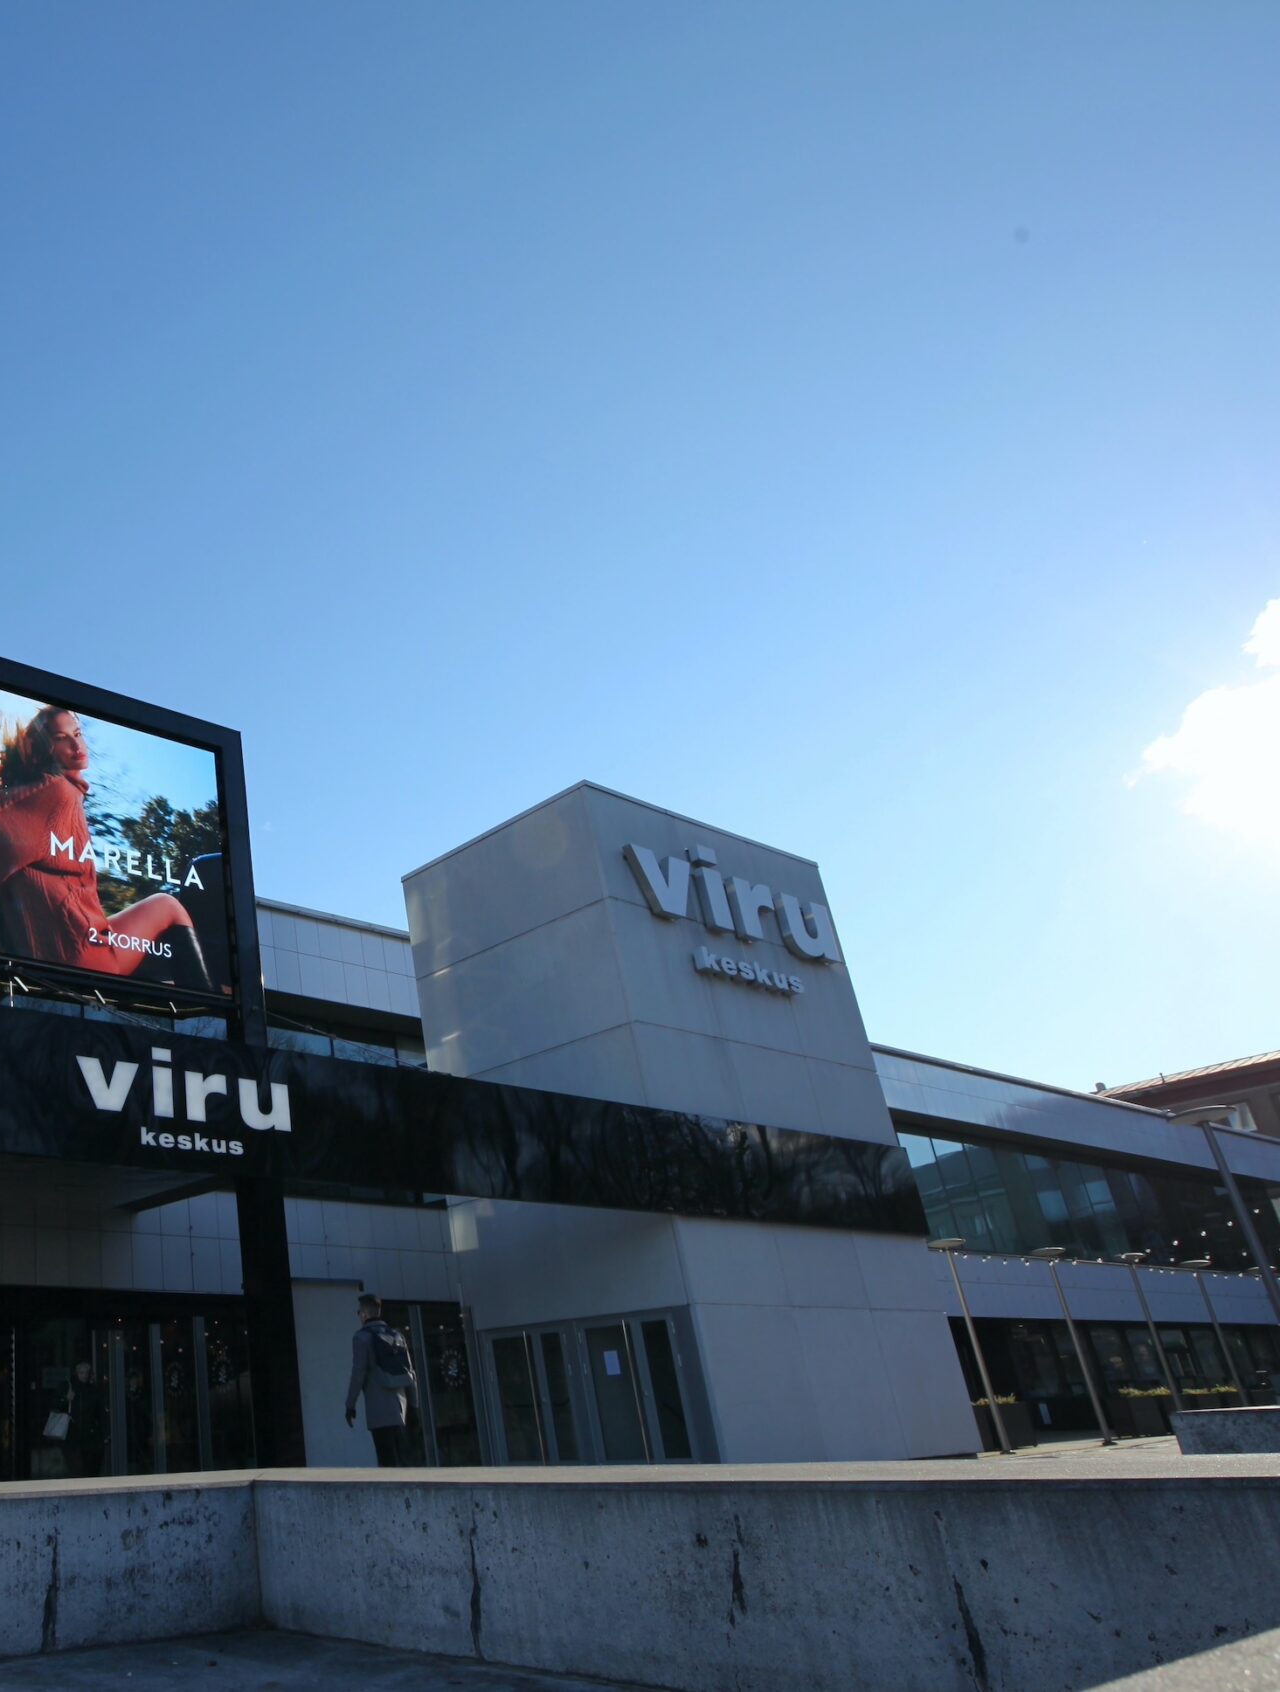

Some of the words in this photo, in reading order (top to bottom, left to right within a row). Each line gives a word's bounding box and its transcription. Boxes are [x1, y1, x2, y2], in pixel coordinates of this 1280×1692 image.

[50, 831, 204, 890] MARELLA
[623, 843, 842, 964] viru
[88, 927, 103, 944] 2.
[108, 933, 172, 958] KORRUS
[692, 945, 805, 995] keskus
[76, 1046, 292, 1133] viru
[140, 1126, 245, 1156] keskus
